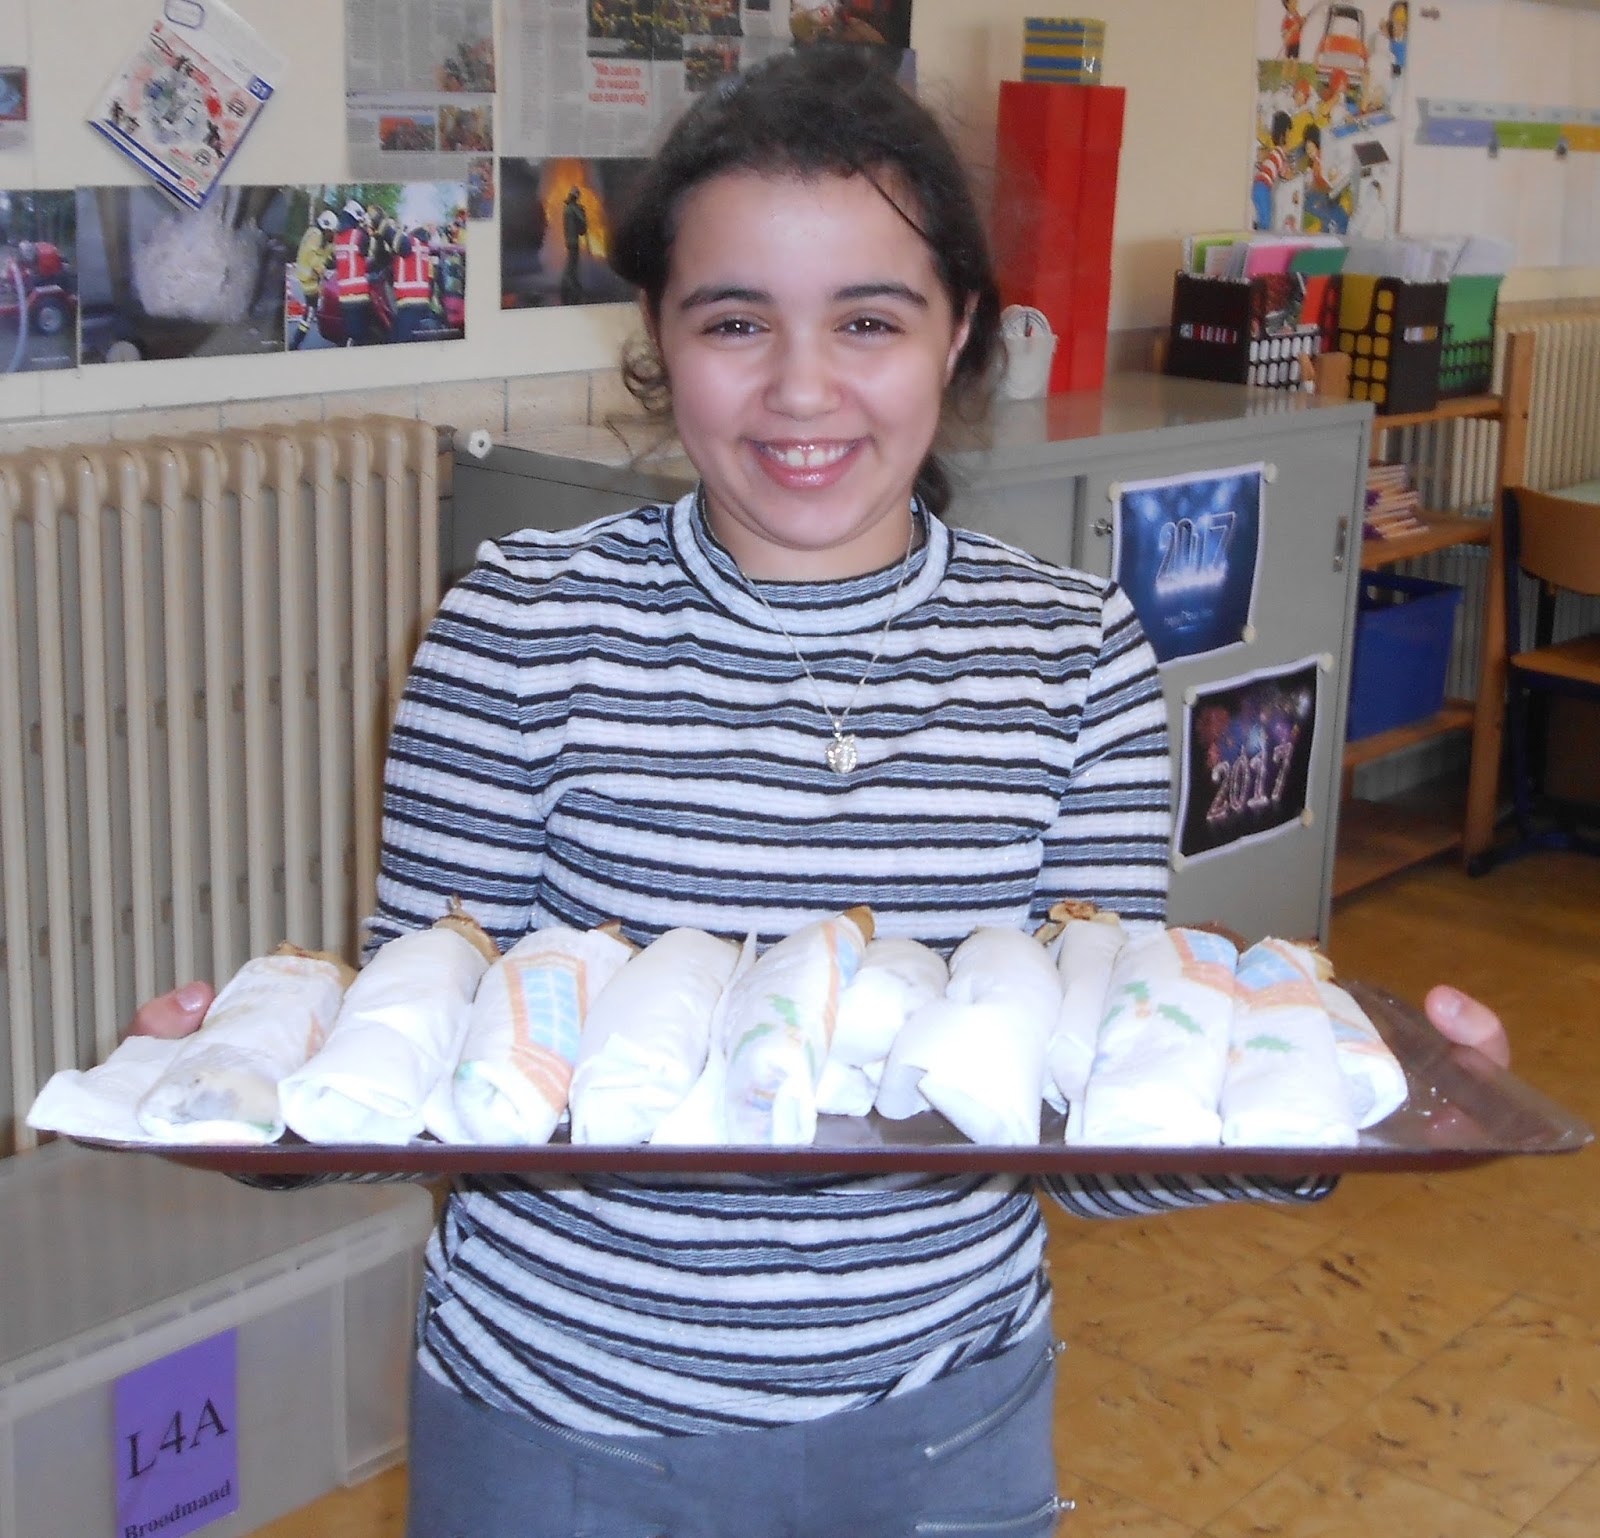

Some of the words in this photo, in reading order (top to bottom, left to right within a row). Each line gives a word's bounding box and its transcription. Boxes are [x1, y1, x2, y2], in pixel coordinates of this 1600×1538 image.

[1156, 511, 1236, 593] 2017
[1206, 742, 1293, 821] 2017
[127, 1397, 229, 1480] L4A
[124, 1479, 231, 1538] Broodmand
